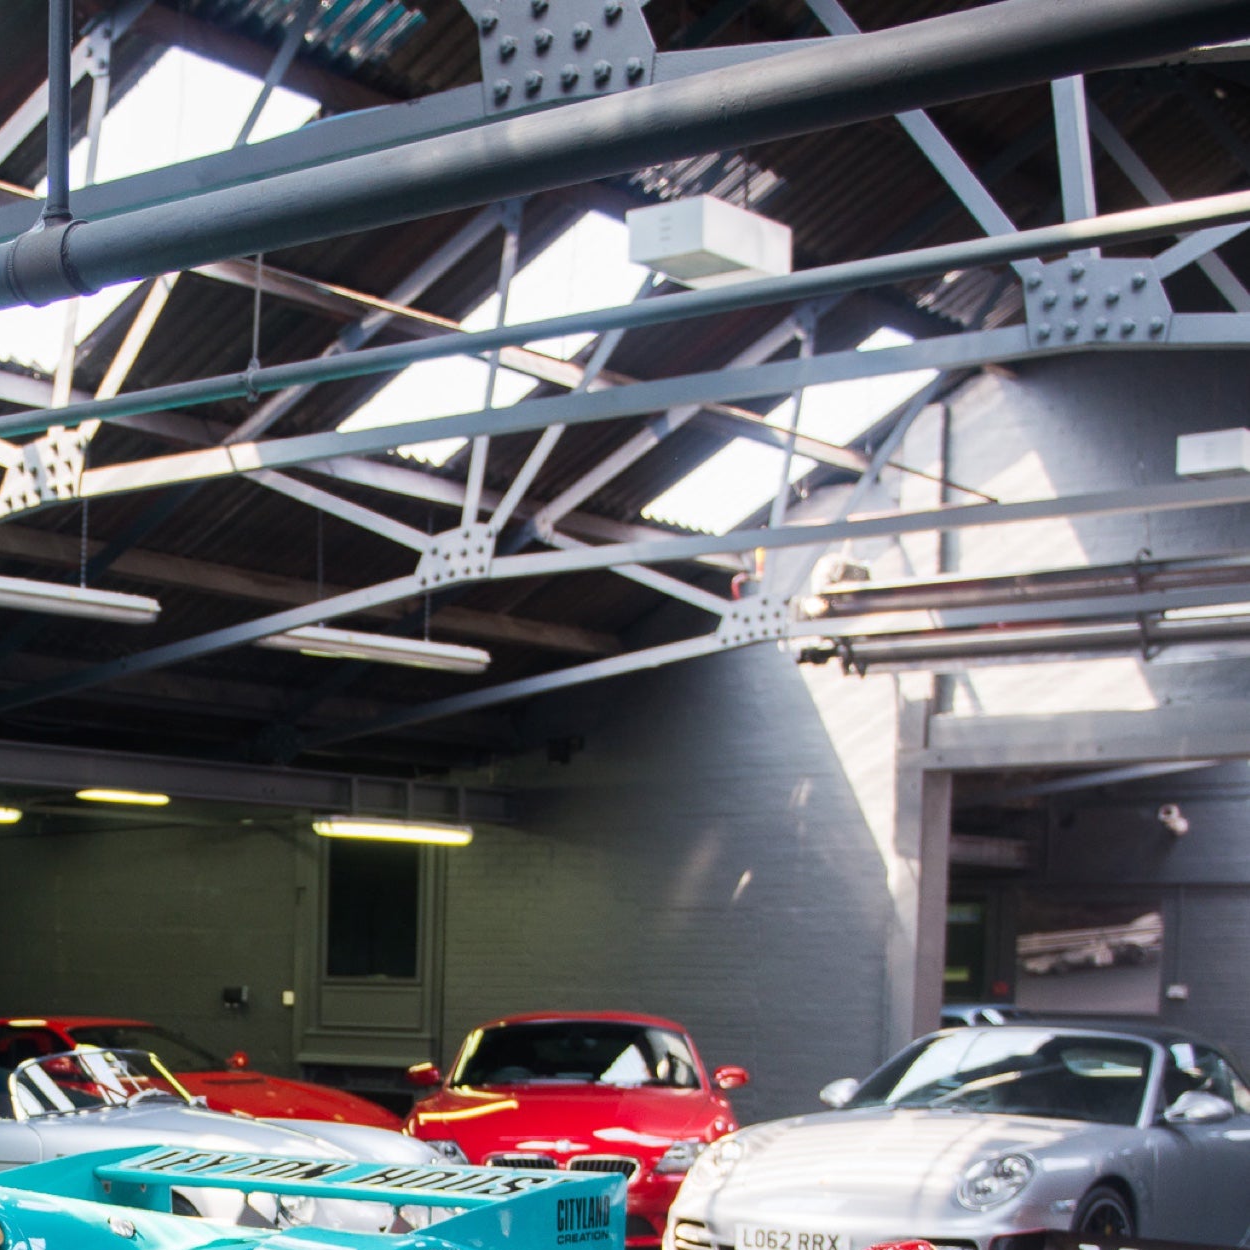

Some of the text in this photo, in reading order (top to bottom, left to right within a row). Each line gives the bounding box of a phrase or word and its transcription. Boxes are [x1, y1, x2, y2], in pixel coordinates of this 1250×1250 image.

[136, 1149, 572, 1196] LEYTON HOUS
[557, 1195, 610, 1232] CITYLAND
[557, 1230, 609, 1245] CREATION
